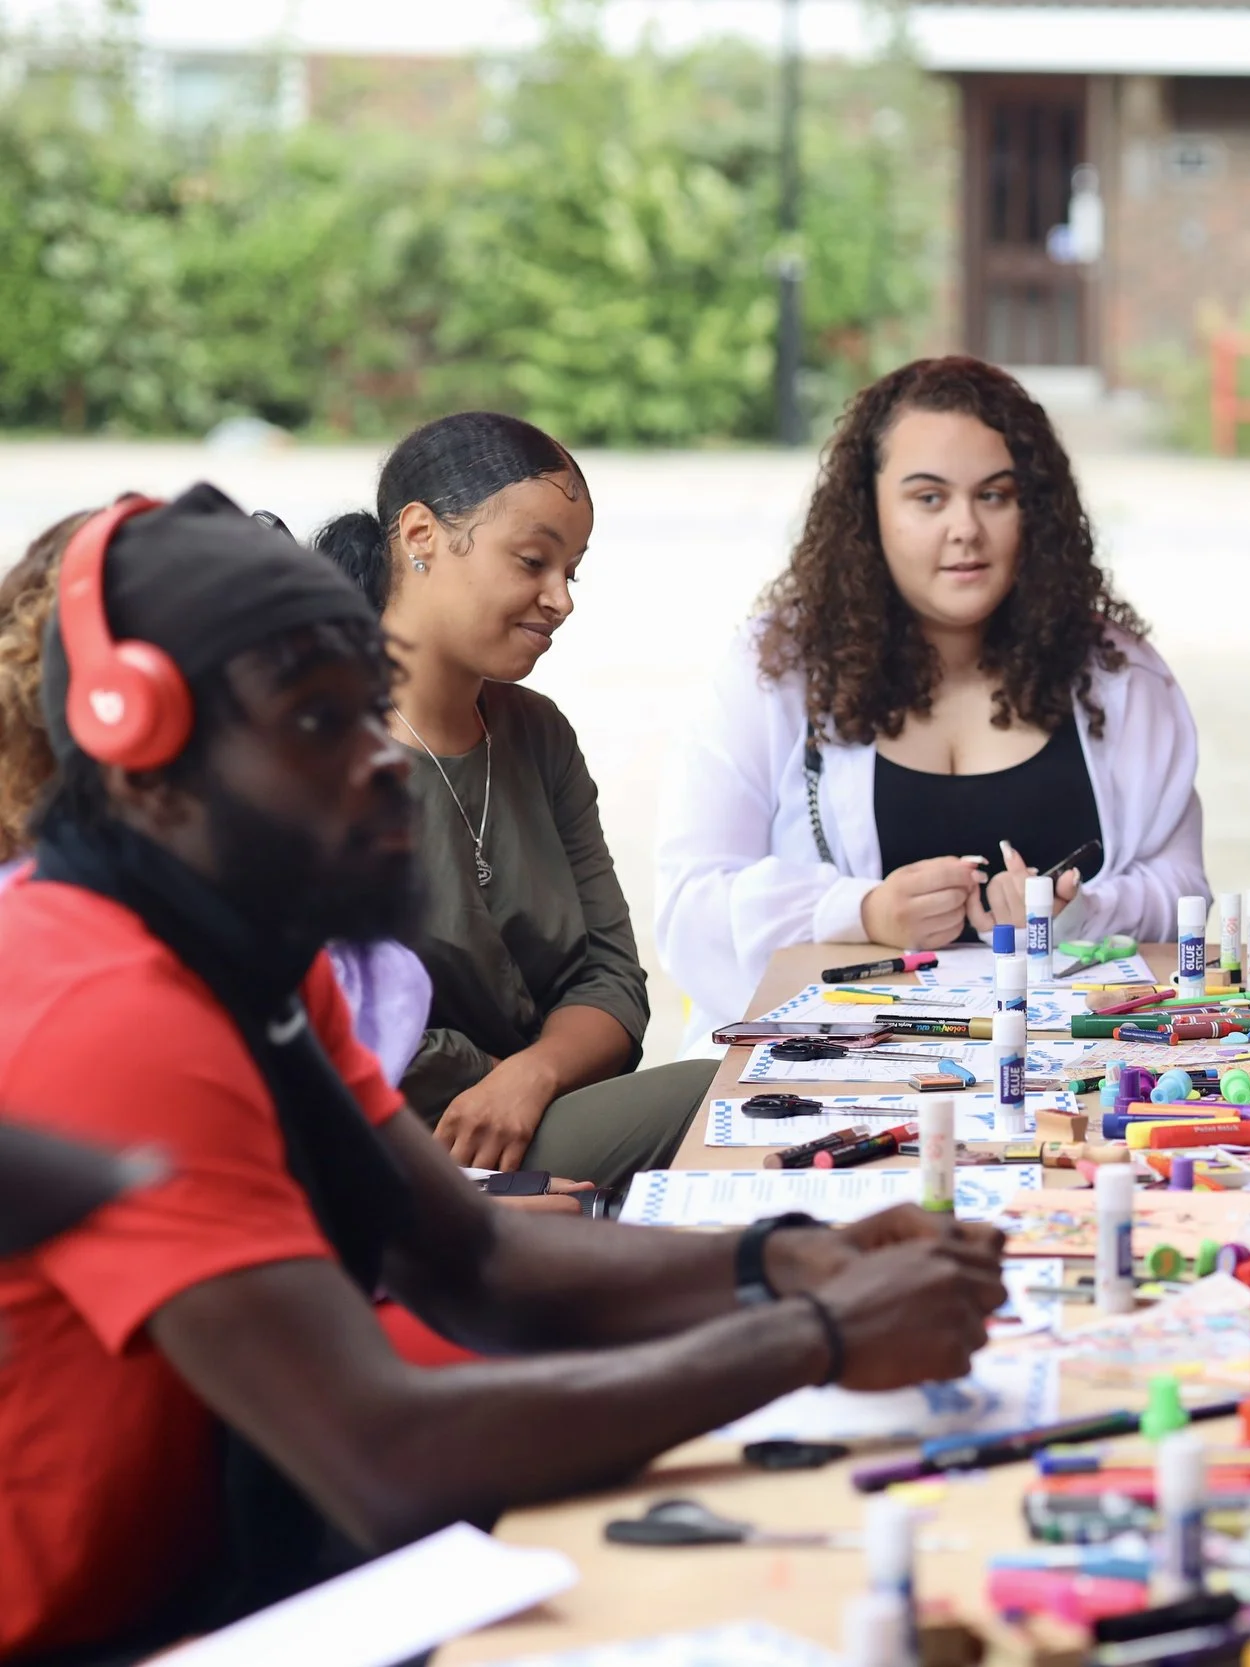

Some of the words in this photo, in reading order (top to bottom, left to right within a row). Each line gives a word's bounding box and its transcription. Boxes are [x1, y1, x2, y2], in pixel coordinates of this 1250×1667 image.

[1029, 924, 1037, 949] GLUE
[1037, 923, 1047, 950] STICK
[1186, 944, 1195, 971] GLUE
[1195, 944, 1204, 971] STICK
[932, 1022, 967, 1034] colorful
[1010, 1066, 1020, 1096] GLUE
